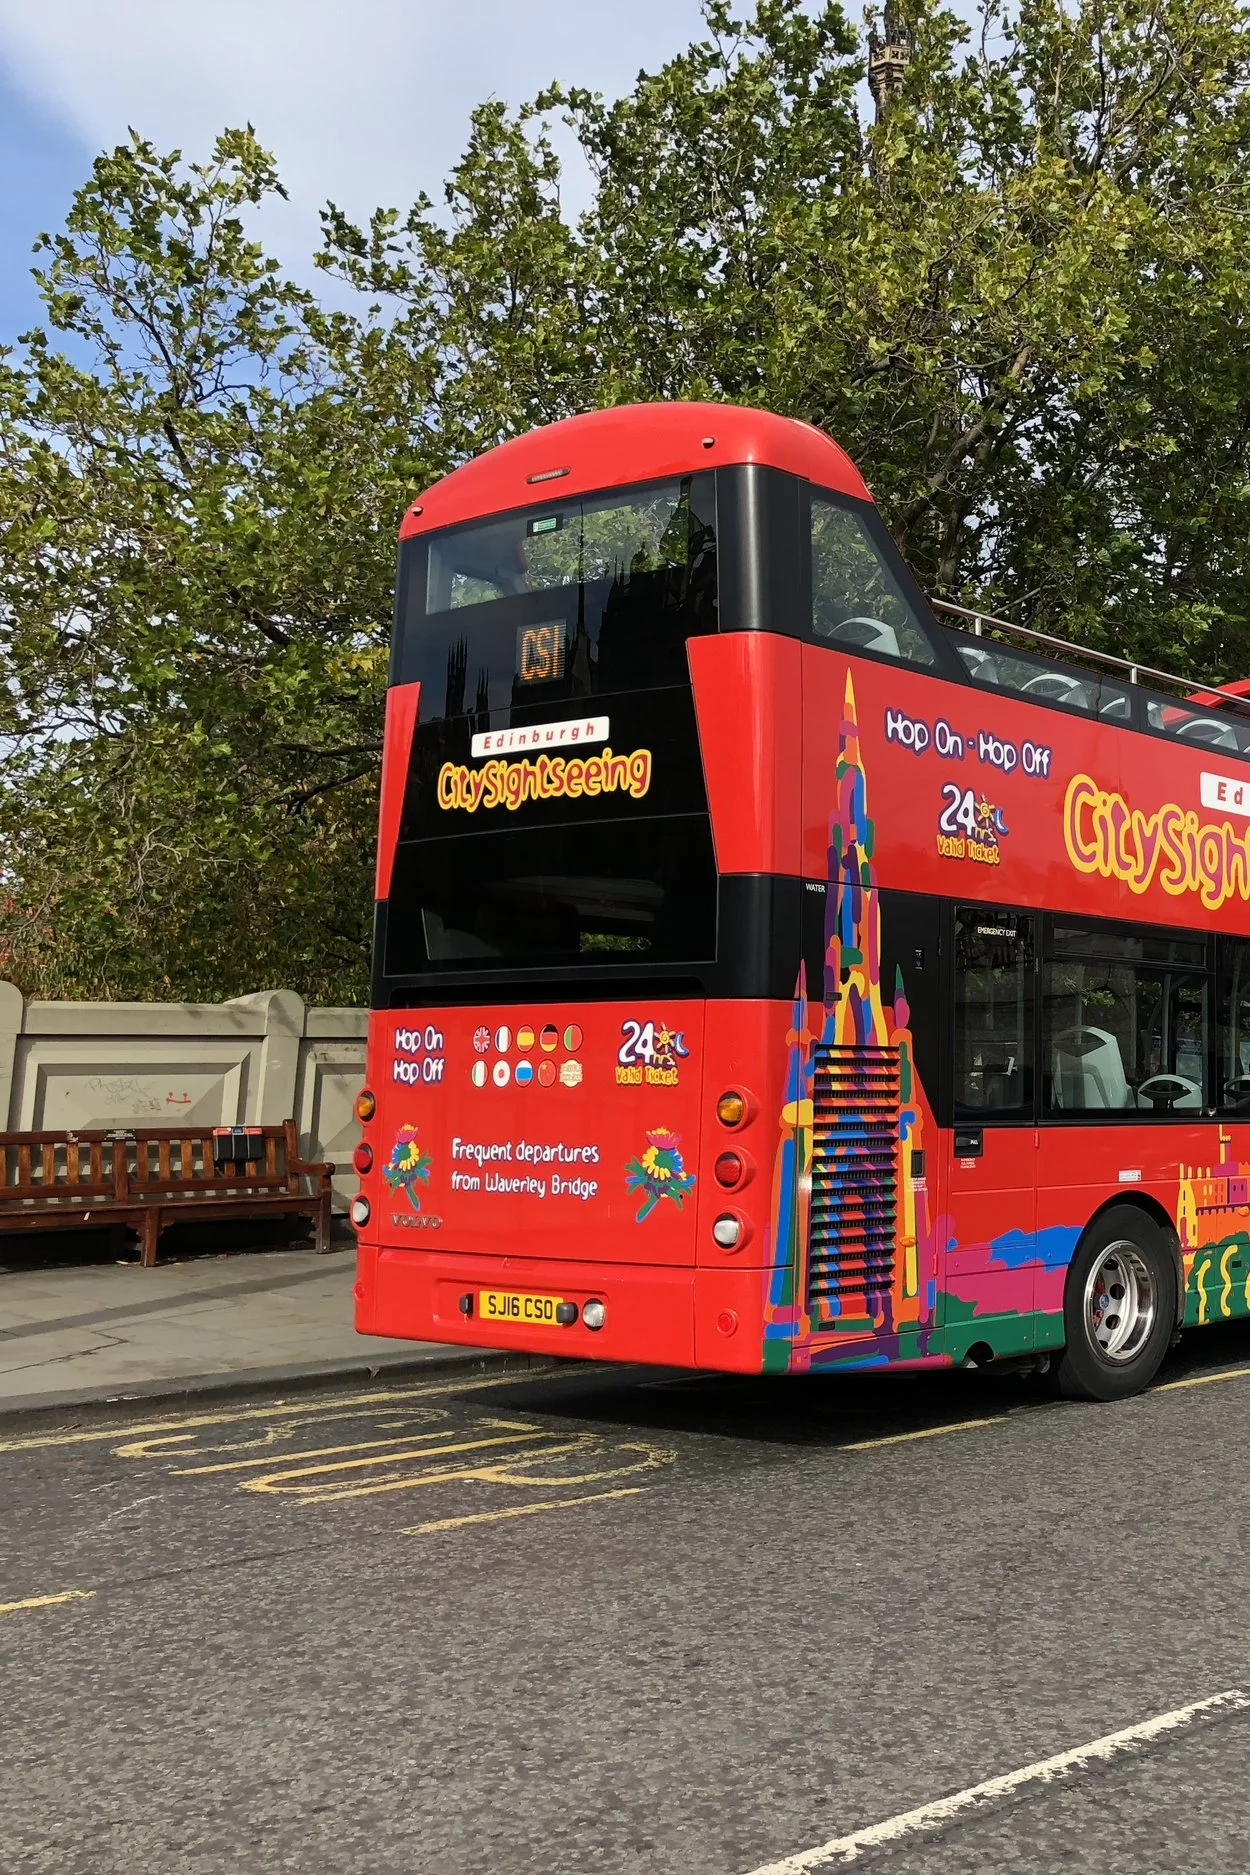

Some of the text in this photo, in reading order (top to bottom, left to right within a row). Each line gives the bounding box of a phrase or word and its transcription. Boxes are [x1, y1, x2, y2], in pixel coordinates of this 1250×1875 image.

[483, 722, 595, 750] Edinburgh
[887, 710, 929, 752] Hop
[935, 721, 962, 757] On
[979, 733, 1017, 771] Hop
[1022, 742, 1050, 775] Off
[437, 747, 652, 813] CitySightseeing
[939, 784, 977, 836] 24
[936, 834, 1000, 864] Valid Ticket
[805, 882, 825, 893] WATER
[977, 926, 1016, 937] EMERGENCY EXIT
[395, 1025, 443, 1053] Hop On
[618, 1020, 655, 1064] 24
[393, 1057, 445, 1084] Hop Off
[615, 1065, 679, 1085] Valid Ticket
[452, 1137, 600, 1167] Frequent departures
[451, 1171, 598, 1200] from Waverley Bridge
[390, 1213, 442, 1229] VOLVO
[488, 1294, 553, 1320] SJ16 CSO
